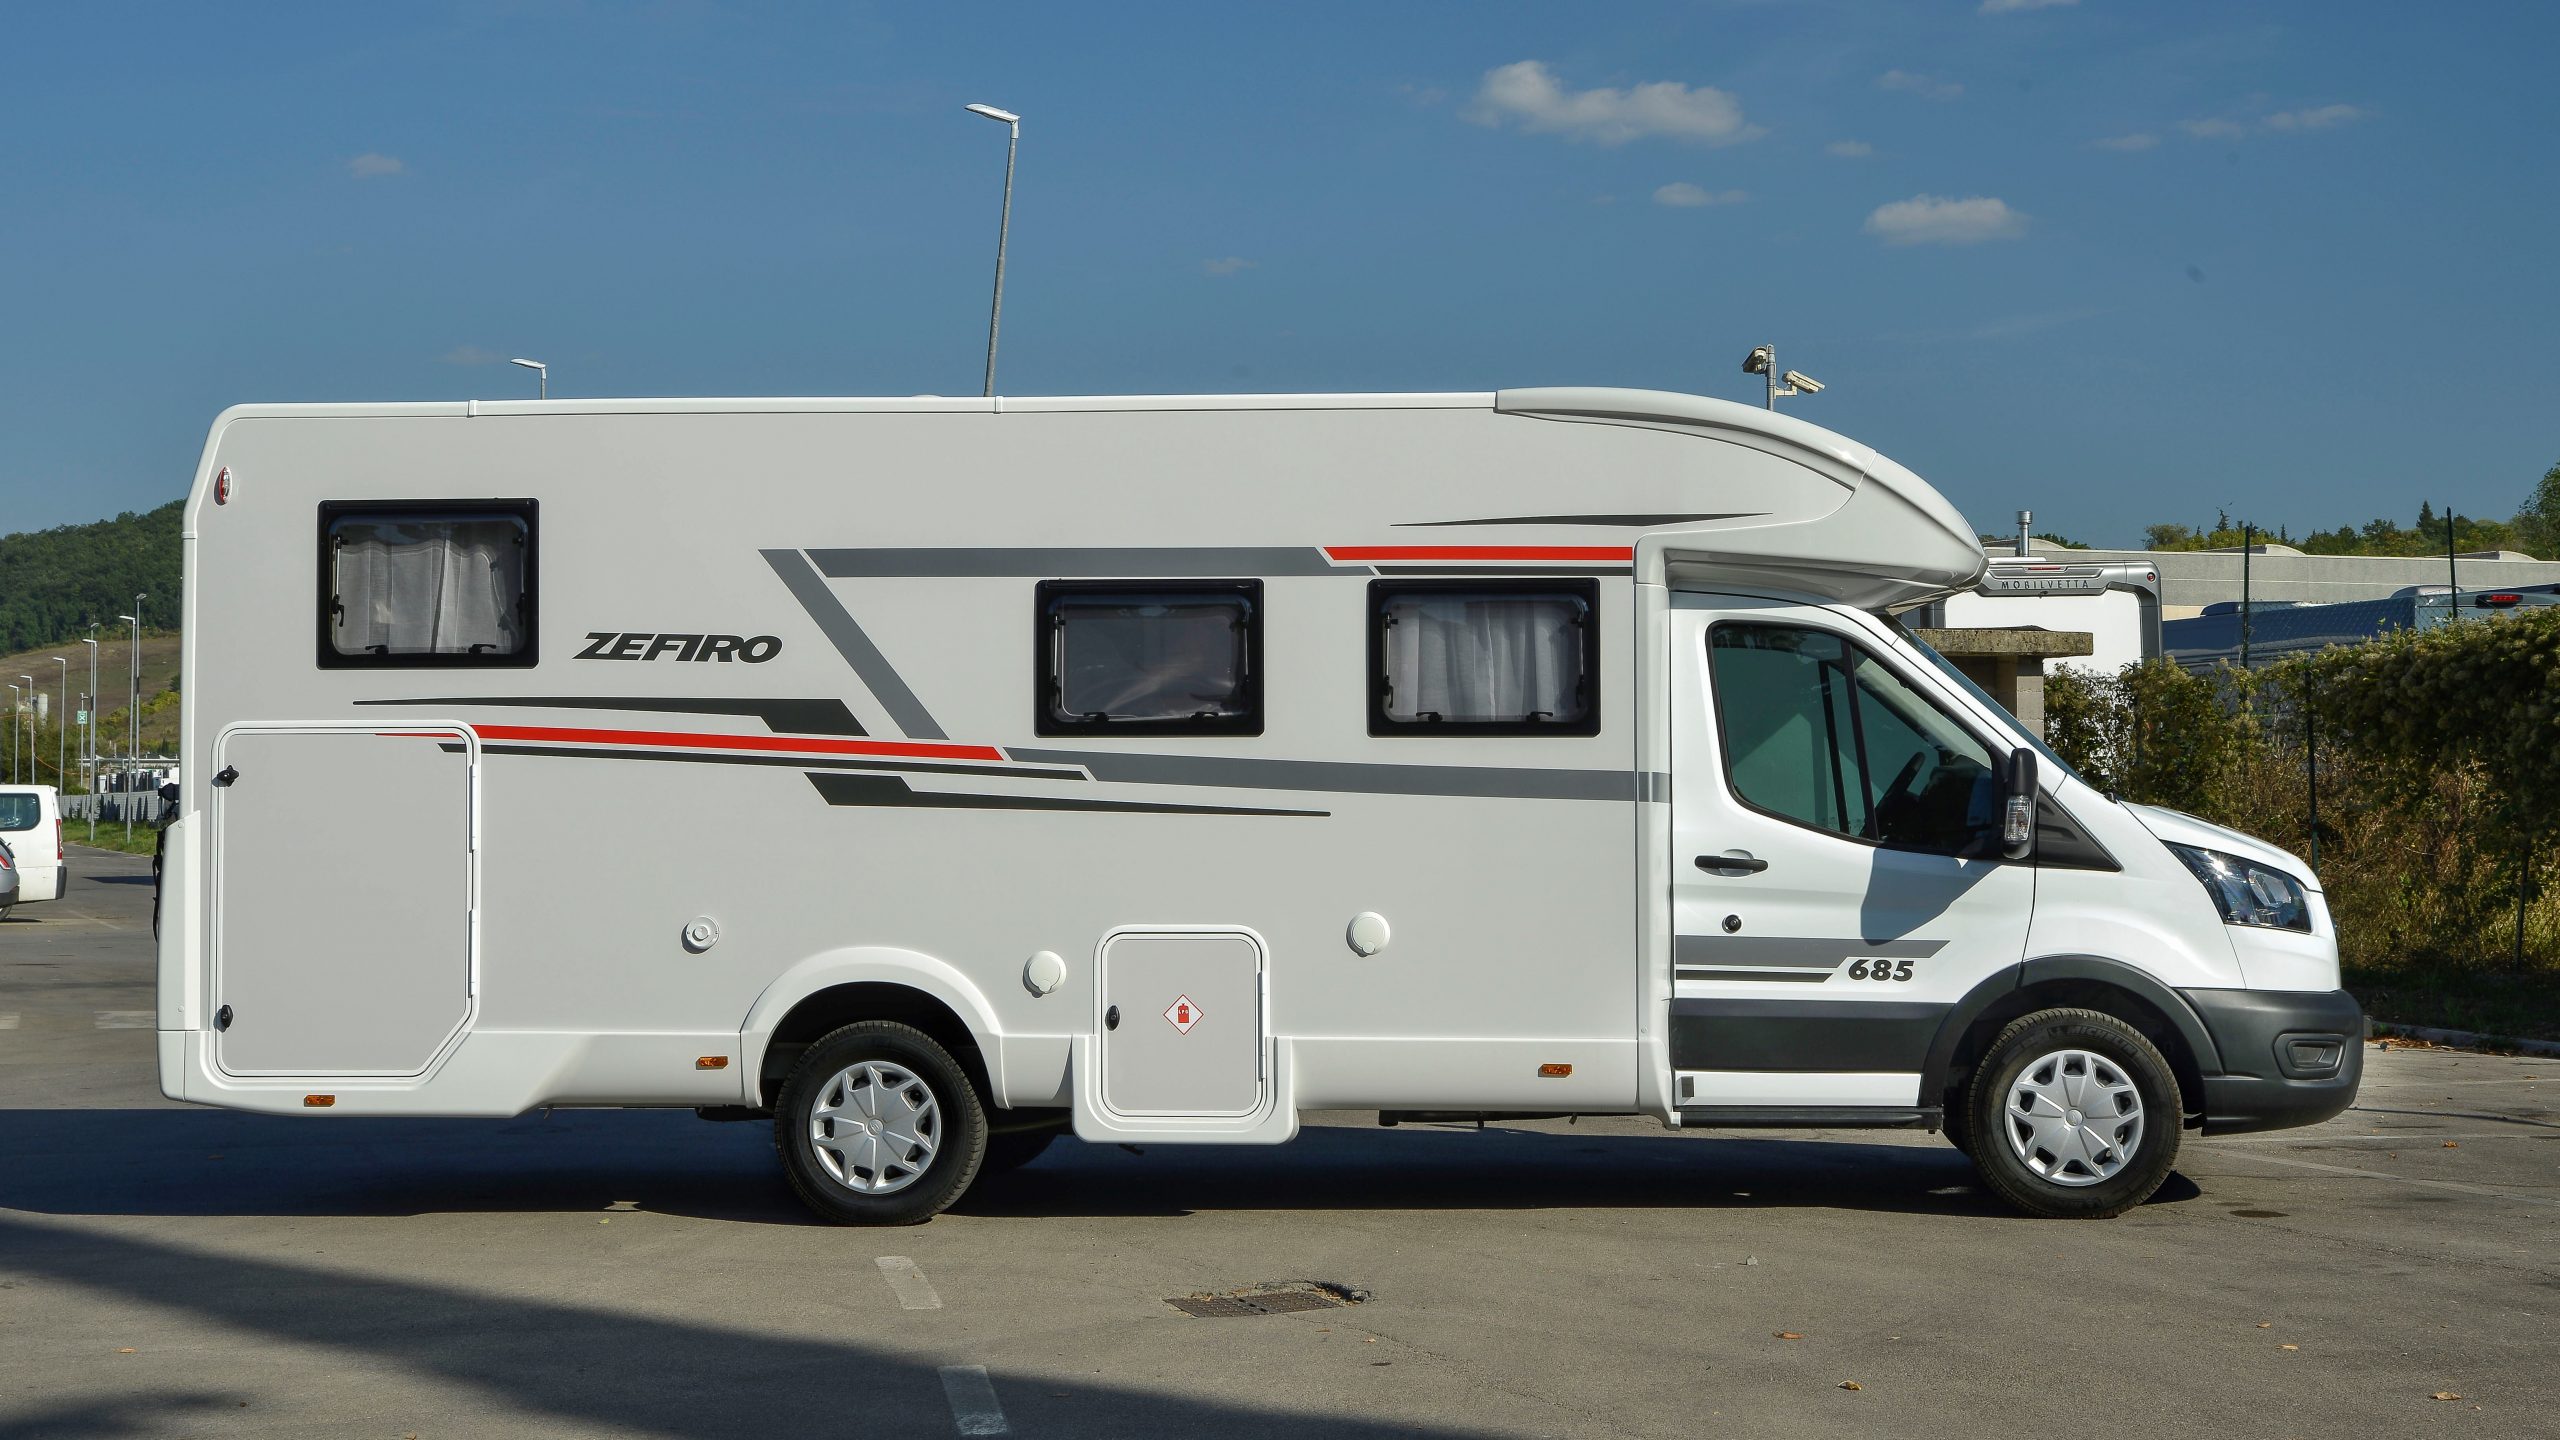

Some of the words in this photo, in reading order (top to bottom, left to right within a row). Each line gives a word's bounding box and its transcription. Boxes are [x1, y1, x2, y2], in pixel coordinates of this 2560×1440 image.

[2001, 580, 2088, 589] MOBILVETTA
[572, 632, 783, 663] ZEFIRO
[1848, 959, 1915, 982] 685
[2066, 1025, 2139, 1056] MICHELIN
